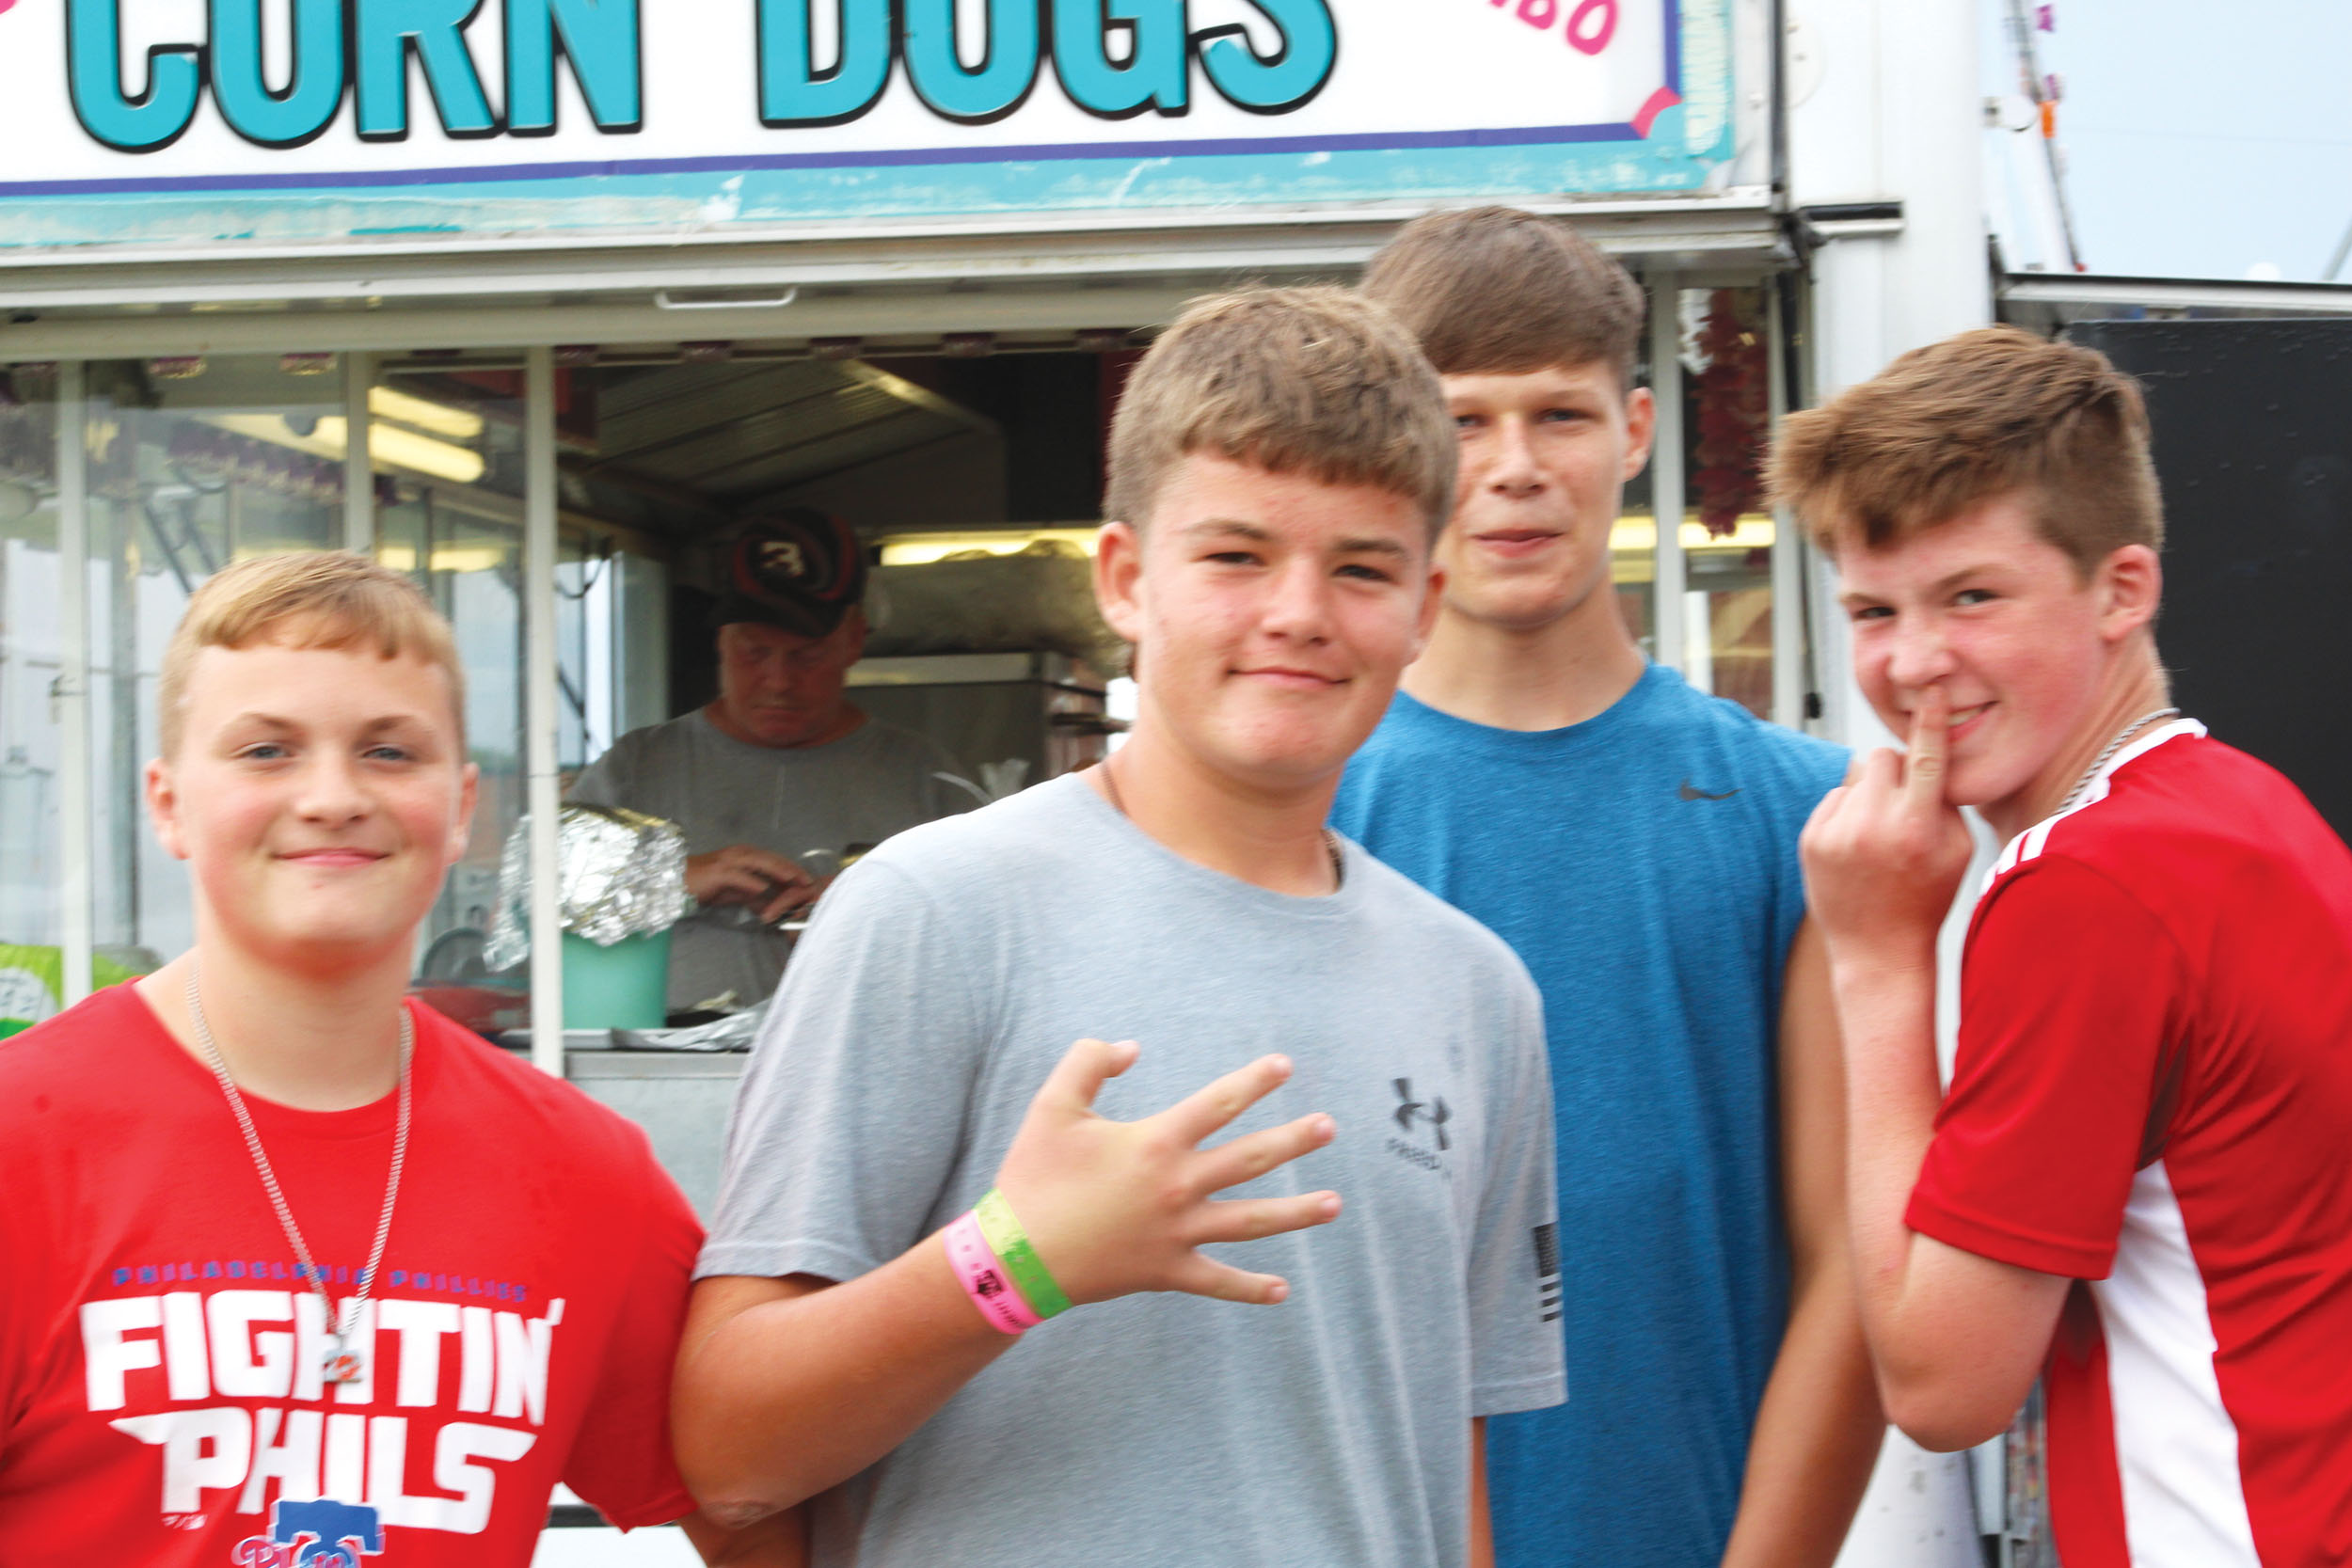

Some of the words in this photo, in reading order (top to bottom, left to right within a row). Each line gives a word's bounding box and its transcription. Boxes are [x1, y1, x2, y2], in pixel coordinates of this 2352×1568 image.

[65, 0, 645, 154] CORN
[755, 0, 1339, 128] DOGS
[389, 1270, 527, 1302] PHILLIES
[107, 1406, 537, 1535] PHILS
